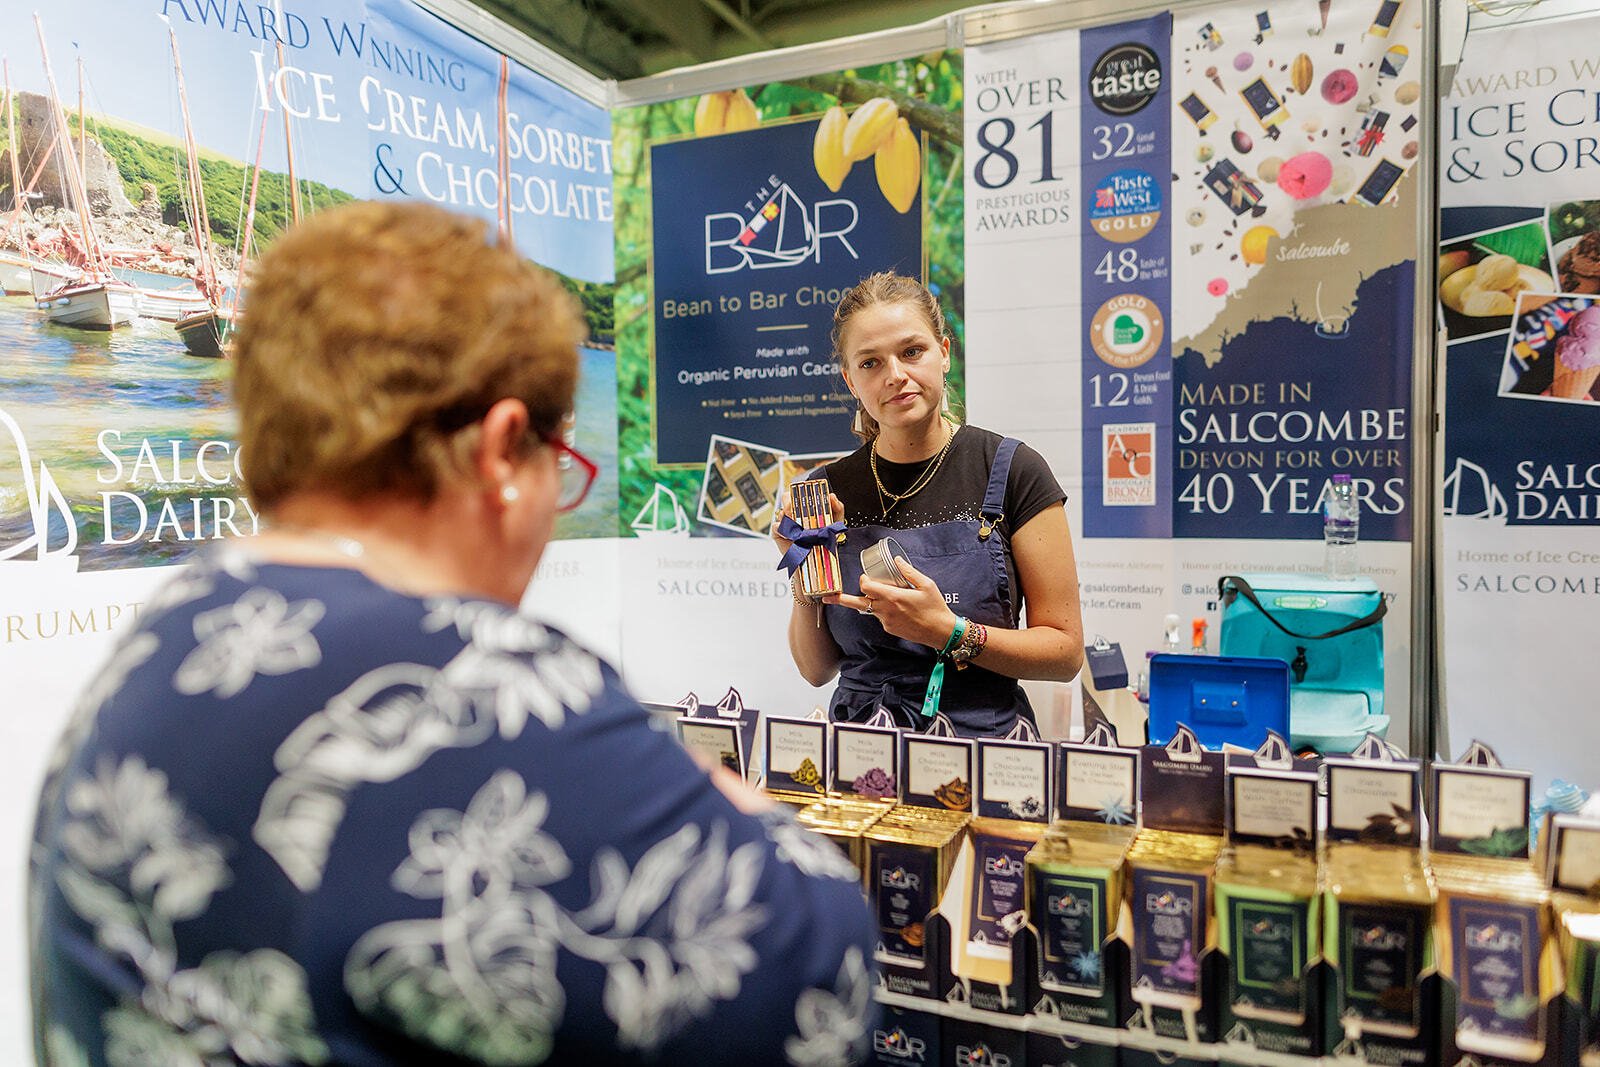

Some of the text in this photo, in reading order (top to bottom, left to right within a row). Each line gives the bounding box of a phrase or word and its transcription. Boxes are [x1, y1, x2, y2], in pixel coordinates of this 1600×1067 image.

[161, 0, 310, 49] AWARD
[975, 69, 1016, 84] WITH
[1092, 68, 1161, 98] taste
[977, 78, 1068, 113] OVER
[250, 50, 612, 175] ICE CREAM, SORBET
[1451, 101, 1527, 142] ICE
[974, 110, 1063, 190] 81
[1092, 122, 1137, 161] 32
[1447, 147, 1487, 183] &
[374, 143, 614, 222] & CHOCOLATE
[744, 173, 782, 212] THE
[1111, 176, 1152, 191] Taste
[976, 189, 1070, 210] PRESTIGIOUS
[1114, 190, 1151, 206] West
[976, 206, 1070, 232] AWARDS
[1099, 214, 1152, 232] GOLD
[1094, 248, 1139, 283] 48
[663, 300, 712, 319] Bean
[720, 296, 741, 312] to
[750, 291, 787, 311] Bar
[1107, 296, 1147, 311] GOLD
[755, 345, 809, 358] Made with
[678, 369, 730, 385] Organic
[734, 364, 798, 380] Peruvian
[1089, 372, 1130, 407] 12
[1180, 382, 1312, 405] MADE IN
[1178, 408, 1406, 444] SALCOMBE
[1180, 447, 1402, 470] DEVON FOR OVER
[1107, 487, 1151, 498] BRONZE
[1178, 472, 1406, 515] 40 YEARS
[97, 490, 260, 545] DAIRY
[1457, 551, 1508, 563] Home
[1513, 550, 1530, 563] of
[1537, 551, 1562, 563] Ice
[1084, 583, 1164, 596] @salcombedairy
